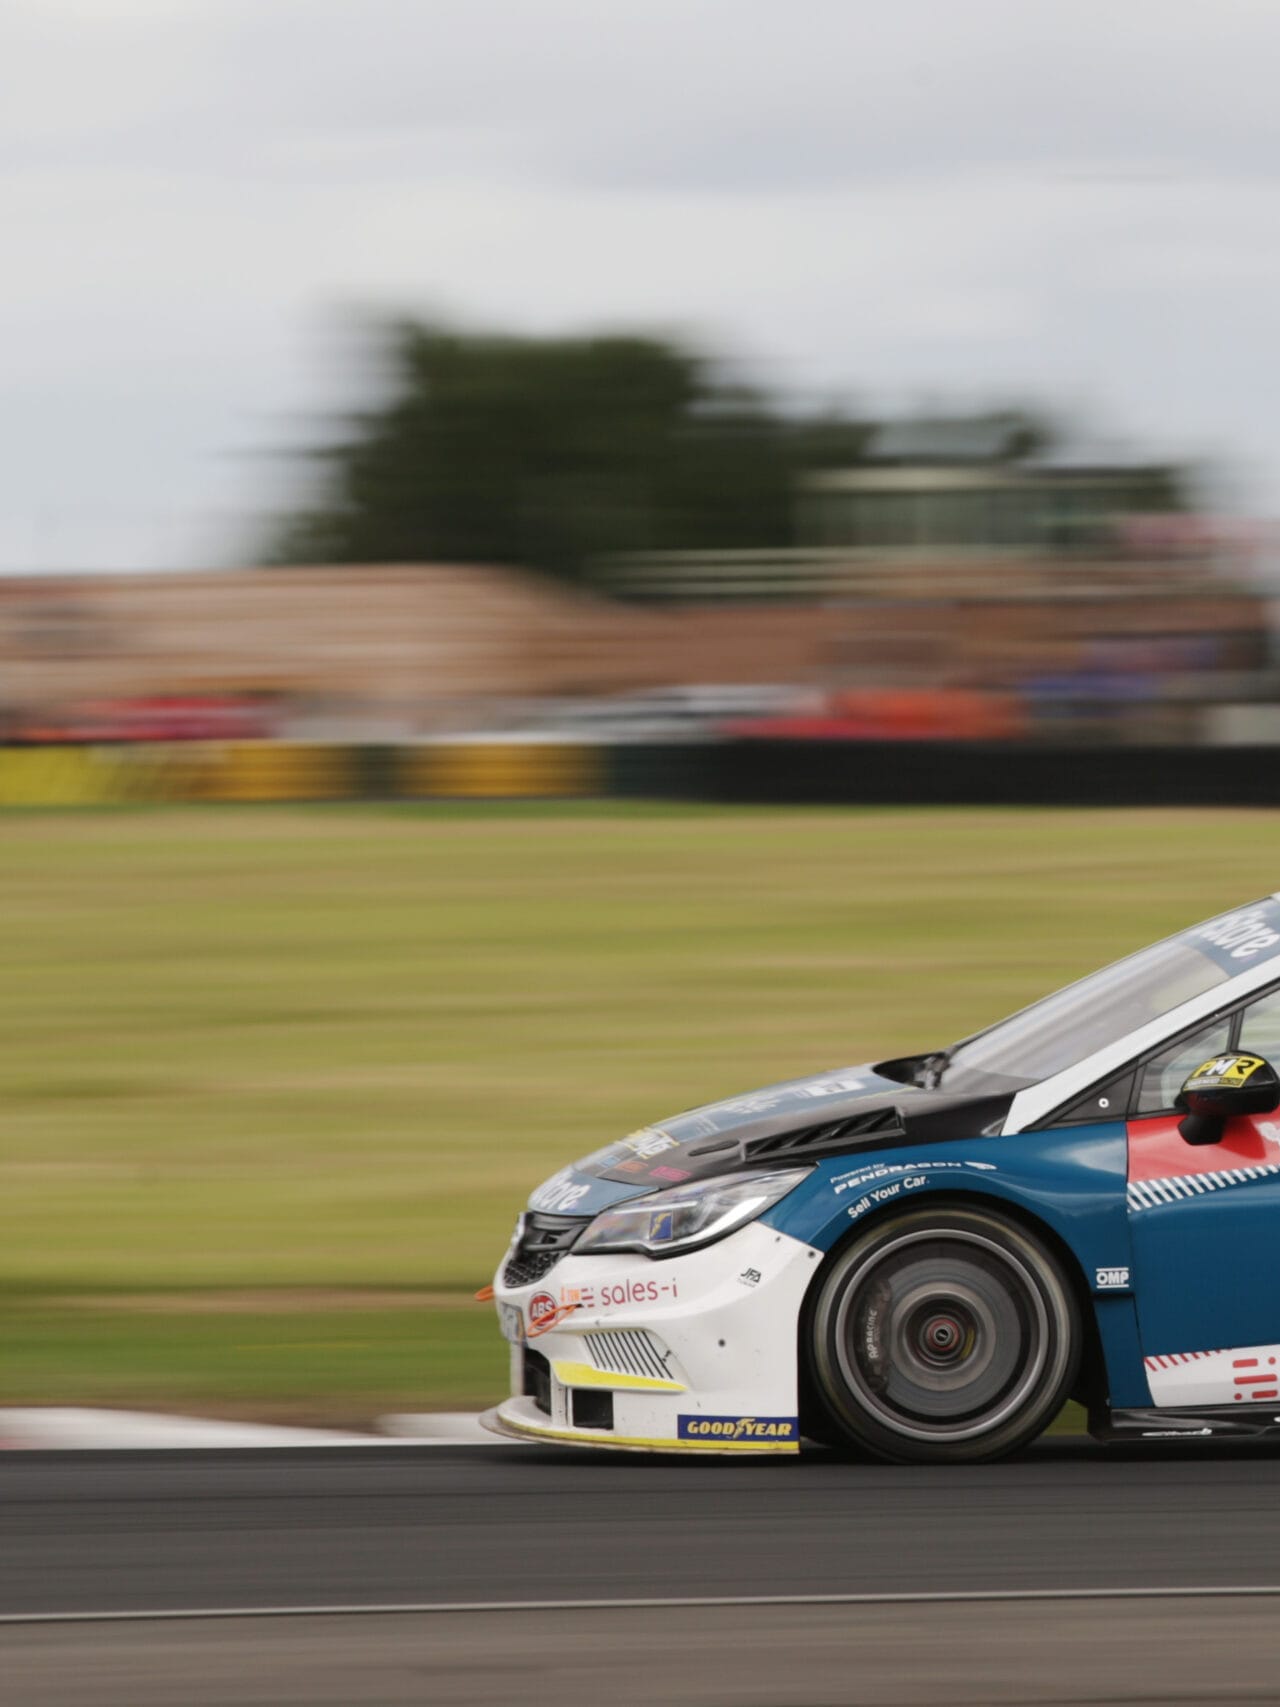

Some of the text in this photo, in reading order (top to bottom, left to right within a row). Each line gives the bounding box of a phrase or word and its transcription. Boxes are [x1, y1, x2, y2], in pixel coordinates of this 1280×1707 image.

[1191, 1058, 1256, 1078] PMR
[833, 1161, 962, 1195] PENDRAGON
[847, 1196, 871, 1219] Sell
[870, 1183, 901, 1202] Your
[741, 1267, 761, 1283] JFA
[1096, 1269, 1129, 1286] OMP
[601, 1277, 678, 1306] sales-i
[531, 1300, 553, 1318] ABS
[687, 1418, 793, 1438] GOODYEAR
